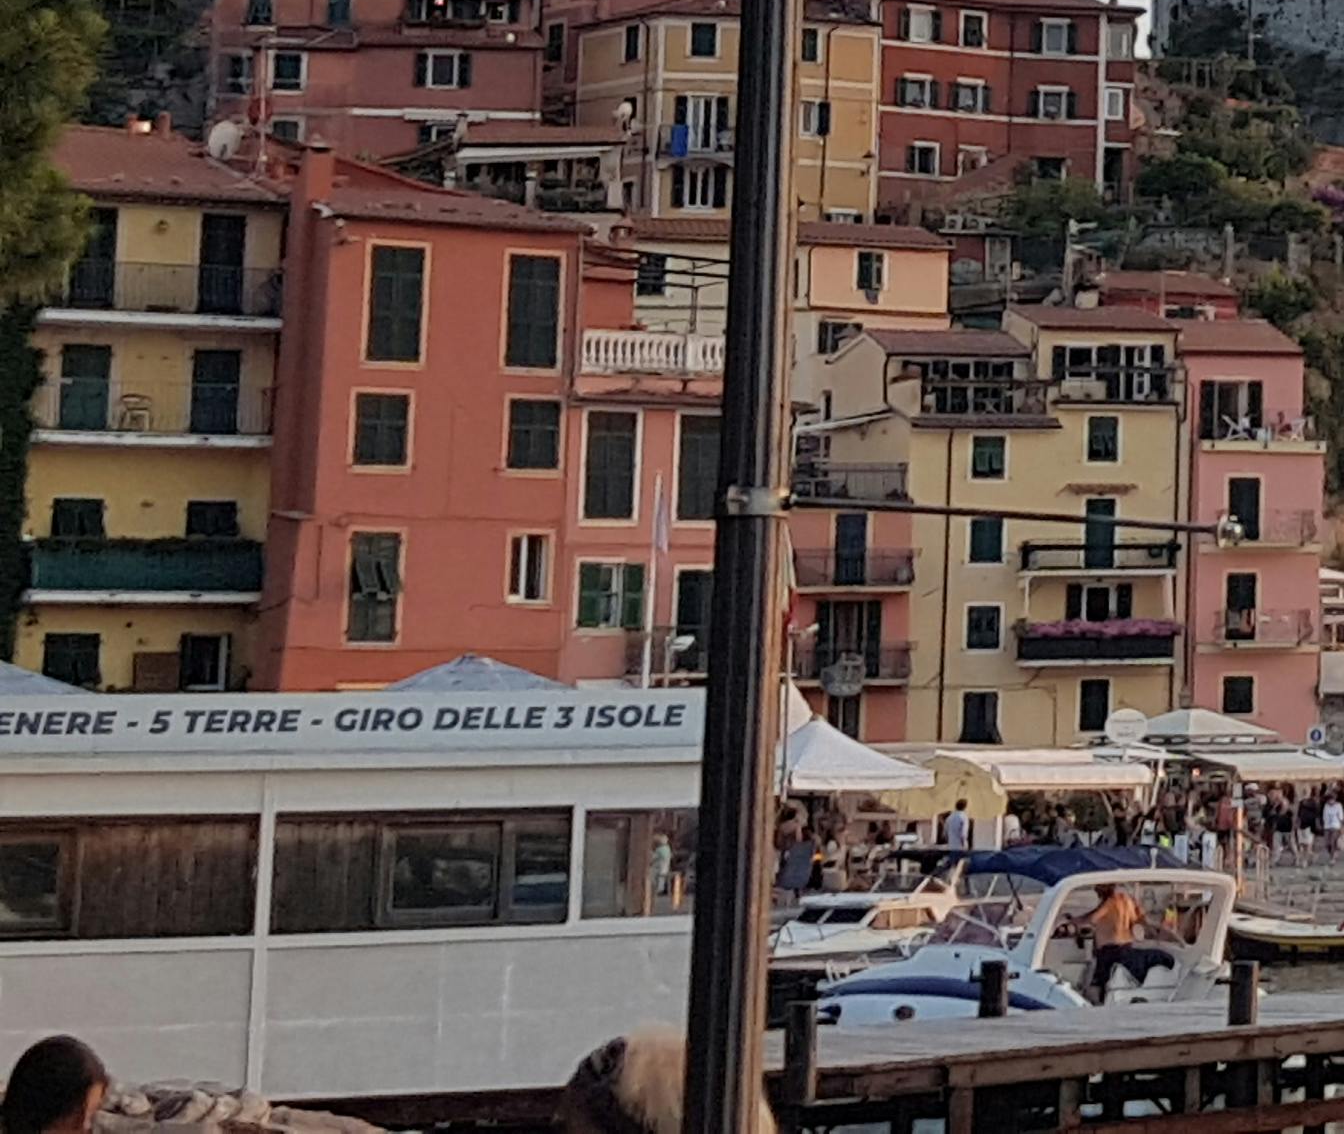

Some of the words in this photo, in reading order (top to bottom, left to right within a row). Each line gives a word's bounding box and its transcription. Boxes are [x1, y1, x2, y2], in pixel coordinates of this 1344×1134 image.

[0, 711, 117, 735] ENERE
[149, 711, 172, 734] 5
[184, 709, 301, 733] TERRE
[334, 707, 423, 732] GIRO
[433, 706, 546, 730] DELLE
[554, 706, 575, 729] 3
[583, 704, 686, 729] ISOLE
